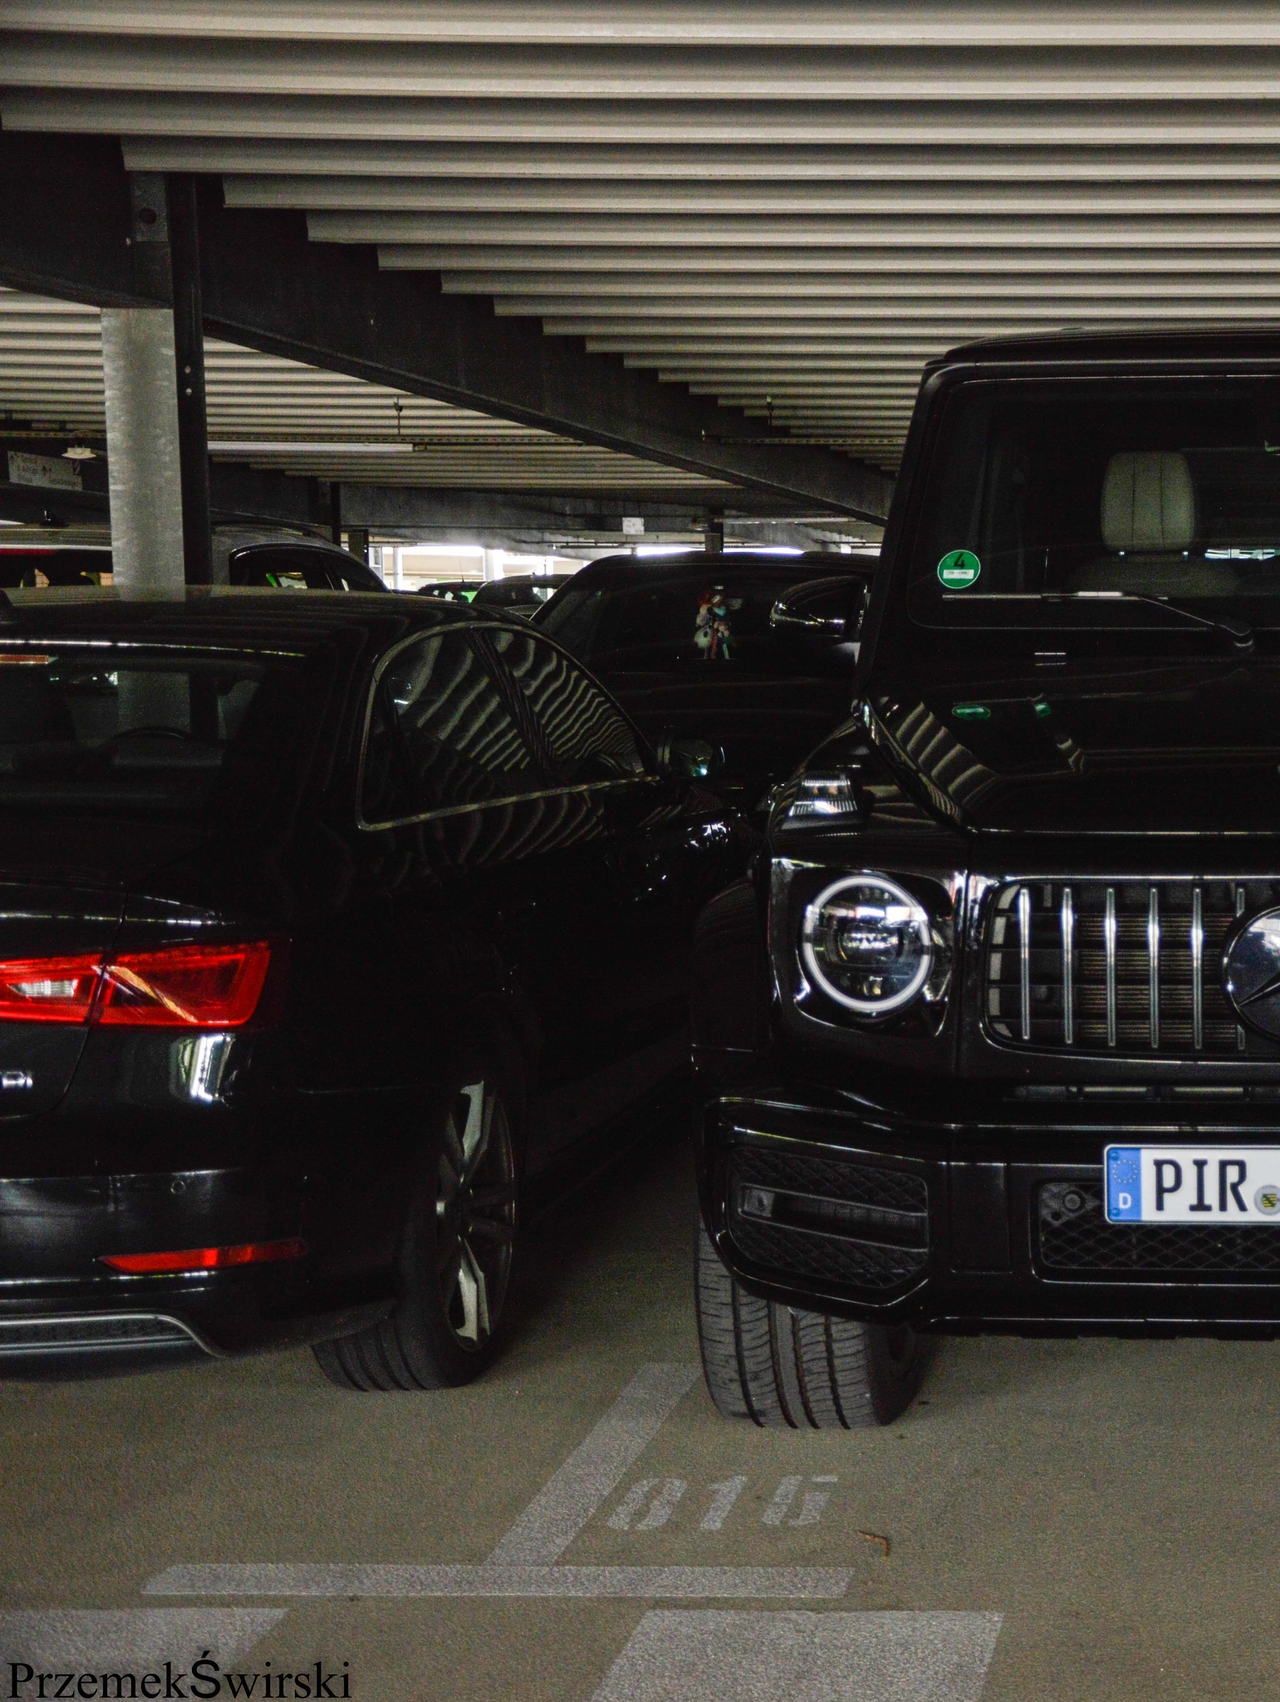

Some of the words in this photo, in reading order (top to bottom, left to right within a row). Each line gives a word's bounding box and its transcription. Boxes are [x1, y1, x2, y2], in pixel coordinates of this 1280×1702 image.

[953, 552, 966, 570] 4
[1118, 1192, 1132, 1209] D
[1153, 1158, 1249, 1213] PIR
